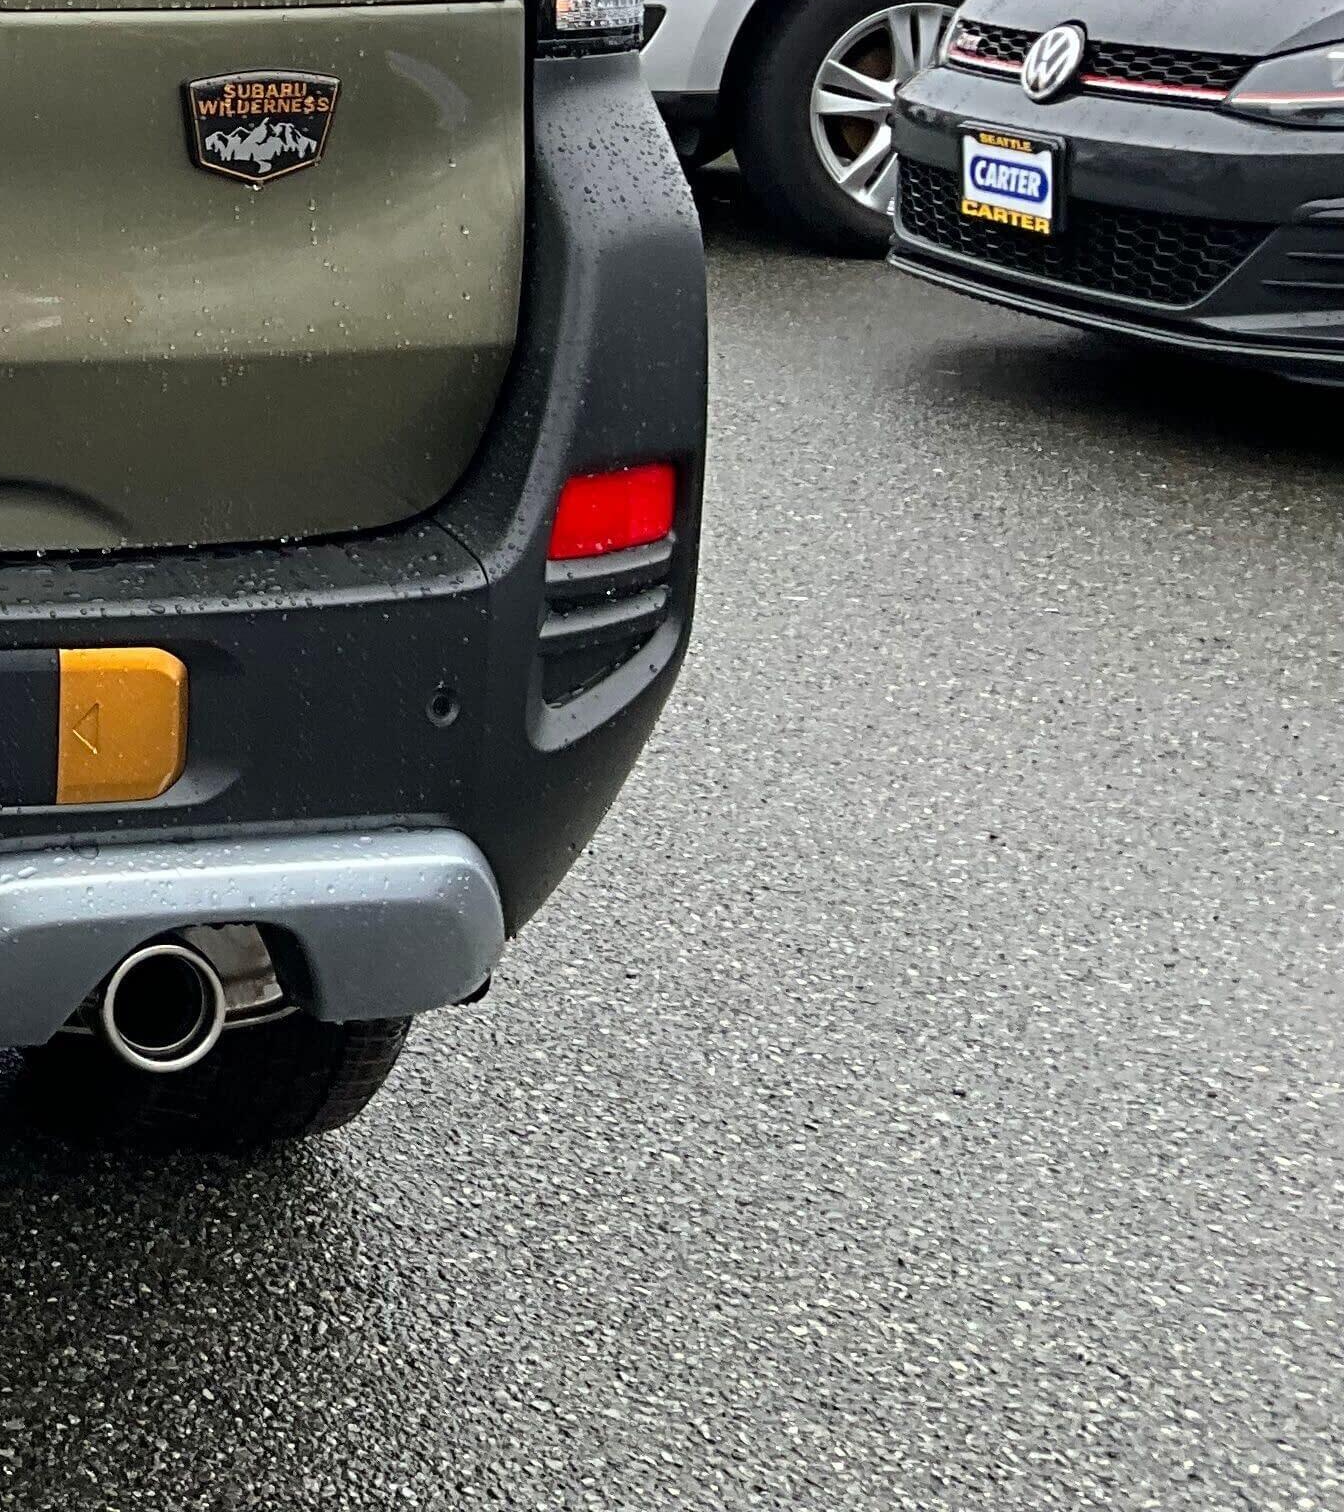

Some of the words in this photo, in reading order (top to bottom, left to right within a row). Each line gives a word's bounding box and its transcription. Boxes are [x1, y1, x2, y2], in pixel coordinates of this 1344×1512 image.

[223, 82, 307, 99] SUBARU
[198, 96, 331, 117] WILDERNESS
[979, 131, 1033, 152] SEATTLE
[974, 159, 1042, 198] CARTER
[961, 199, 1050, 235] CARTER
